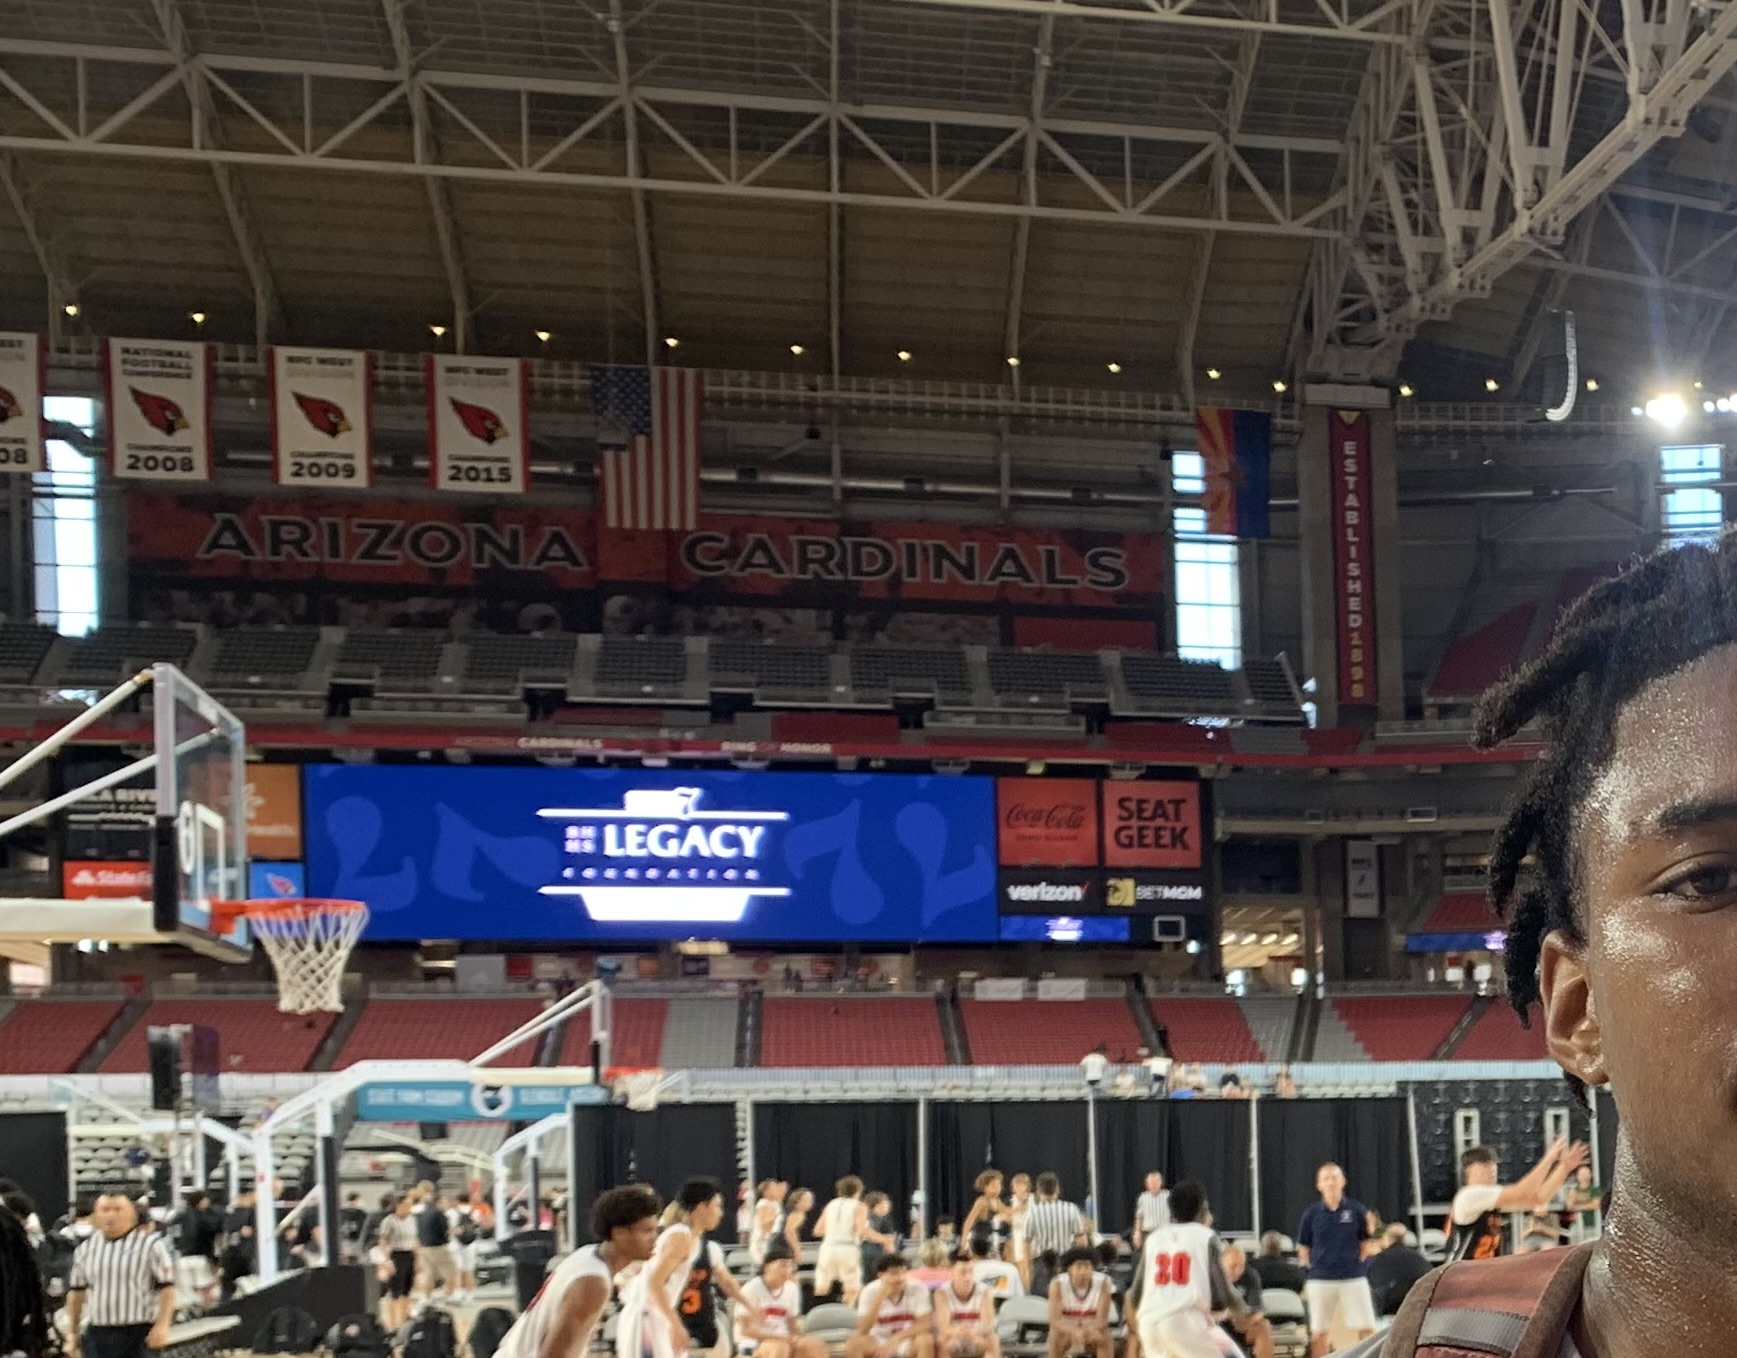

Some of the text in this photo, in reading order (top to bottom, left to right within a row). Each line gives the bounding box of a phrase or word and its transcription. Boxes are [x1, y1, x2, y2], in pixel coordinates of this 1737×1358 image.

[0, 447, 28, 464] 08
[127, 454, 194, 472] 2008
[290, 461, 356, 478] 2009
[448, 464, 511, 483] 2015
[1343, 441, 1363, 628] ESTABLISHED
[197, 512, 1130, 592] ARIZONA CARDINALS
[1118, 797, 1186, 823] SEAT
[604, 824, 765, 858] LEGACY
[1114, 825, 1190, 850] GEEK
[1006, 881, 1084, 901] verizon
[1136, 885, 1203, 901] BETMGM
[1155, 1250, 1191, 1287] 30
